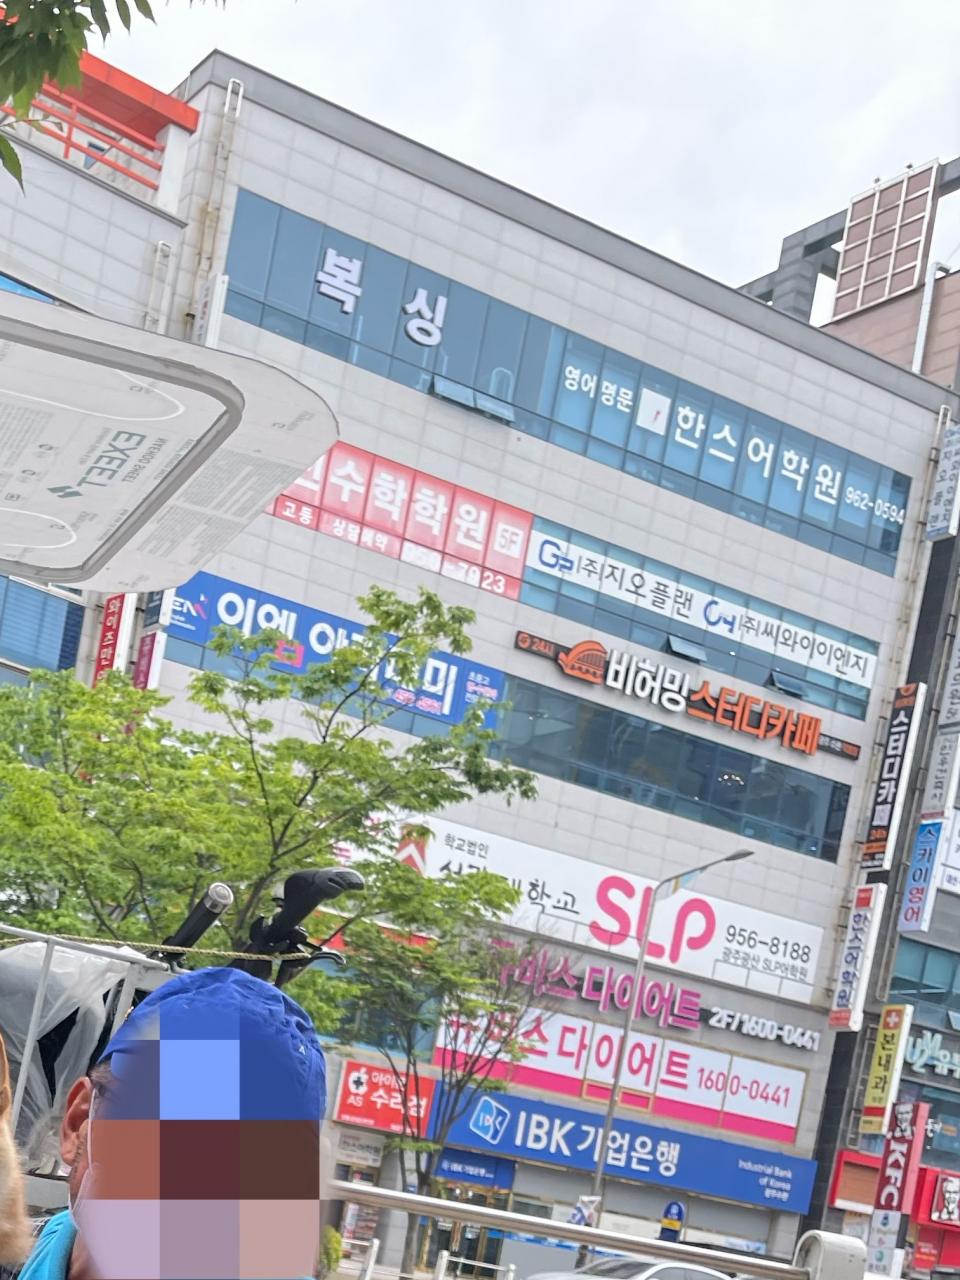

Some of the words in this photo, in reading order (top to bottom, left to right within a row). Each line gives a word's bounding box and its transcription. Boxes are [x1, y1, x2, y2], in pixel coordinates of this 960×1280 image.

[564, 365, 597, 399] 영어
[600, 380, 633, 412] 명문
[674, 405, 842, 505] 한스어학원
[843, 486, 906, 525] 962-0594
[687, 680, 823, 757] 스터디카페
[444, 833, 489, 859] 학교법인
[588, 875, 716, 964] SLP
[726, 923, 811, 963] 956-8188
[697, 1066, 791, 1109] 1600-0441
[871, 1032, 898, 1095] 본내과
[514, 1111, 575, 1156] IBK
[577, 1124, 681, 1177] 기업은행
[774, 1166, 793, 1179] Bank
[880, 1140, 907, 1209] KFC
